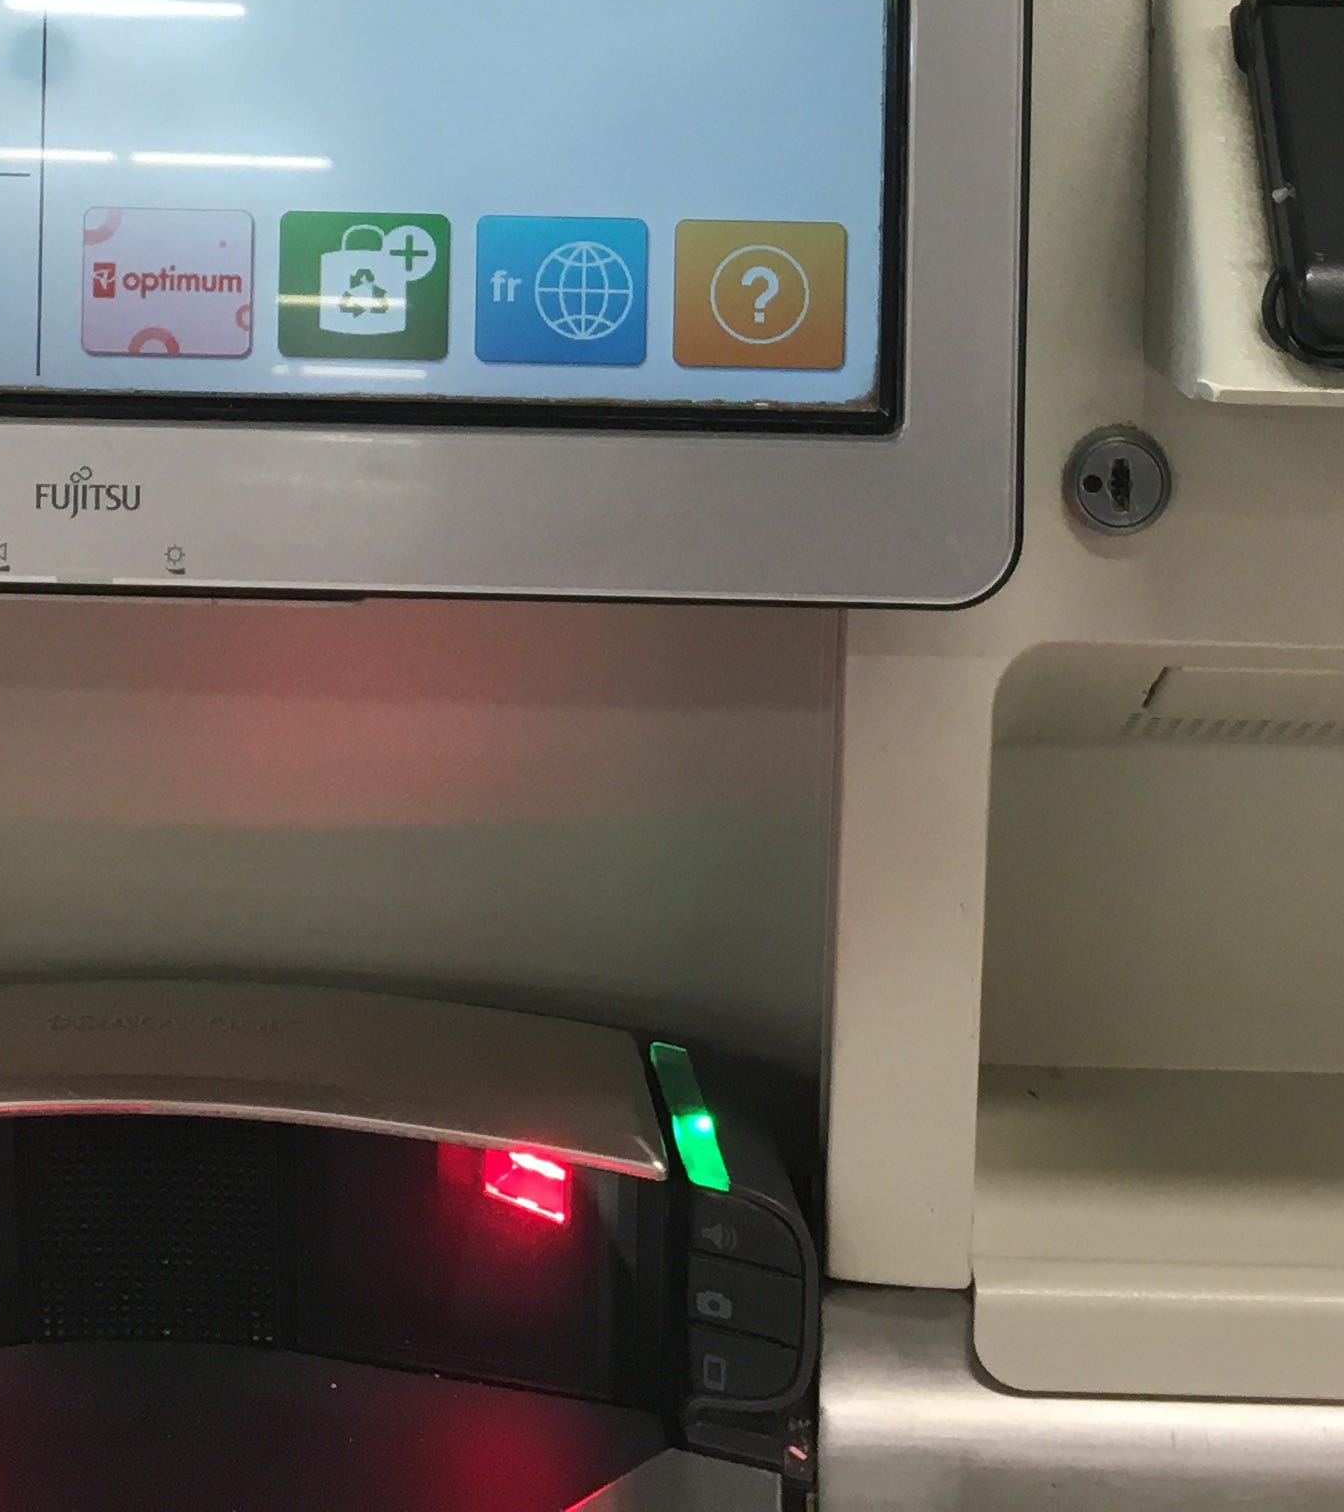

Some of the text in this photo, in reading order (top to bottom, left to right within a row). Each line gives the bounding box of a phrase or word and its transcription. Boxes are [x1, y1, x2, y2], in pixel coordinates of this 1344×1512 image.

[122, 264, 243, 300] optimum
[491, 270, 522, 302] fr
[35, 474, 141, 519] FUJITSU
